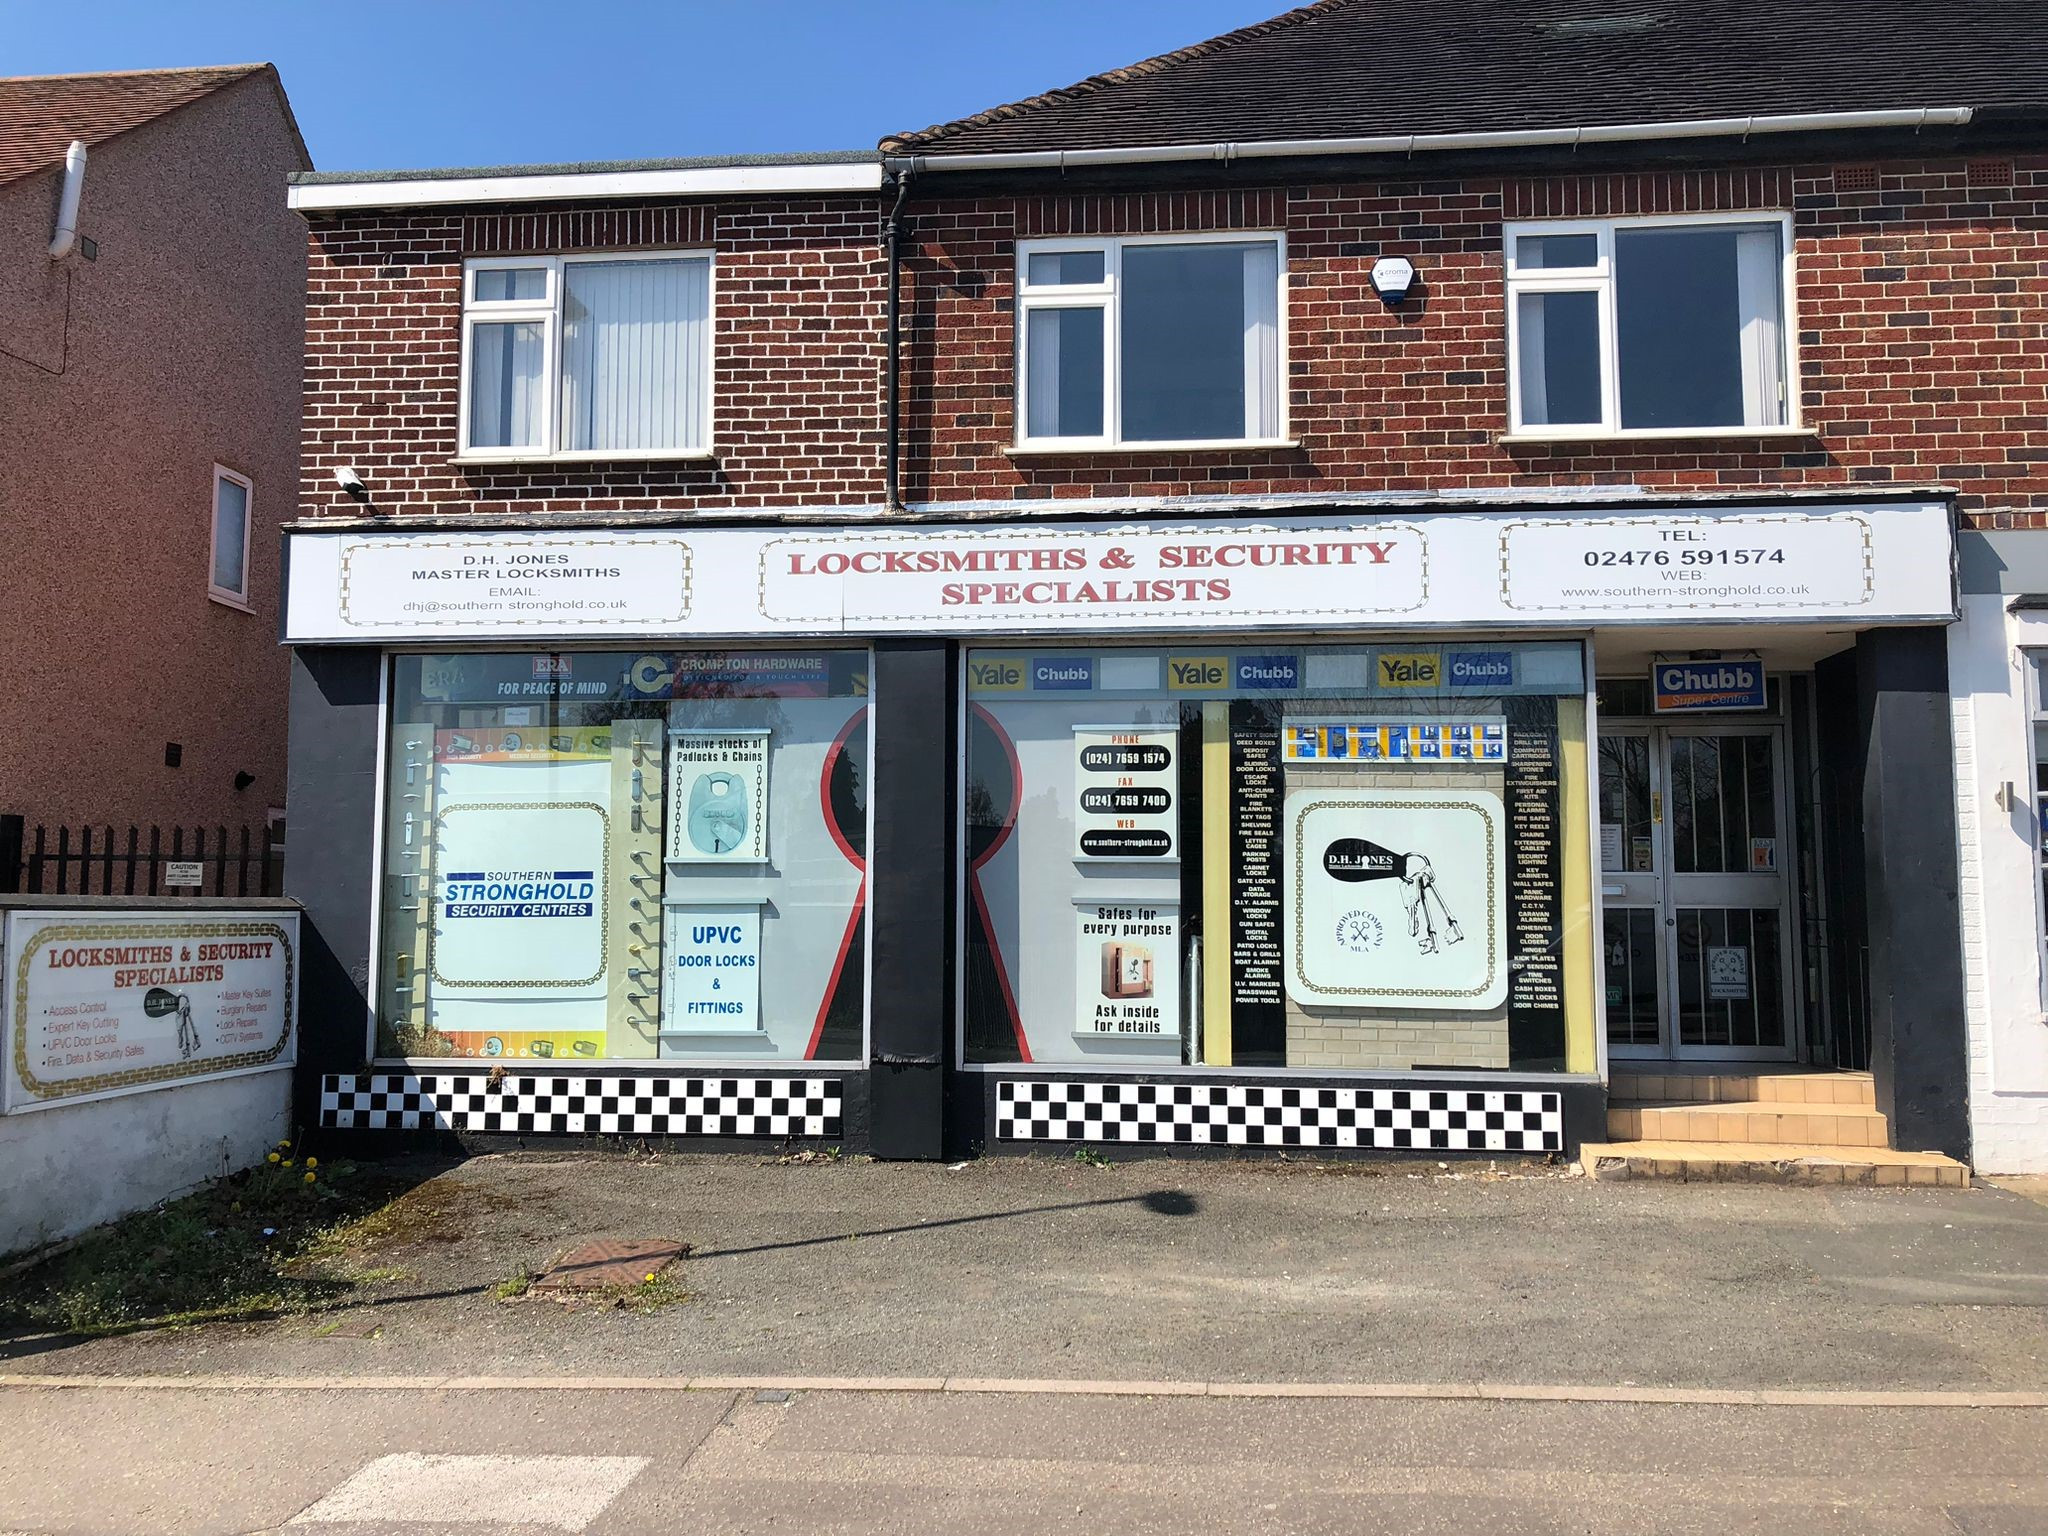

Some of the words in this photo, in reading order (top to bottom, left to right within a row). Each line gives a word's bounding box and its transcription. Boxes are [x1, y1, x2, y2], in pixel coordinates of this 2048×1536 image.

[1658, 530, 1707, 542] TEL:
[463, 555, 500, 566] D.H.
[505, 554, 569, 565] JONES
[786, 547, 1087, 576] LOCKSMITHS
[1098, 546, 1136, 571] &
[1158, 541, 1398, 569] SECURITY
[1584, 551, 1670, 567] 02476
[1681, 549, 1786, 565] 591574
[412, 570, 490, 580] MASTER
[496, 567, 621, 579] LOCKSMITHS
[1660, 570, 1707, 581] WEB:
[489, 587, 541, 597] EMAIL:
[941, 578, 1232, 606] SPECIALISTS
[1561, 584, 1810, 598] www.southern-stronghold.co.uk
[536, 659, 568, 672] ERA
[681, 659, 750, 670] CROMPTON
[754, 658, 822, 669] HARDWARE
[1453, 662, 1509, 676] Chubb
[971, 664, 1021, 685] Yale
[1036, 667, 1088, 681] Chubb
[1172, 663, 1224, 685] Yale
[1240, 665, 1294, 679] Chubb
[1381, 660, 1435, 682] Yale
[1663, 668, 1753, 691] Chubb
[498, 683, 519, 695] FOR
[523, 682, 556, 695] PEACE
[559, 682, 574, 694] OF
[577, 682, 607, 694] MIND
[1672, 694, 1707, 707] Super
[1710, 693, 1749, 705] Centre
[677, 739, 714, 749] Massive
[718, 739, 749, 749] stocks
[752, 738, 762, 749] of
[1111, 735, 1140, 744] PHONE
[677, 752, 718, 762] Padlocks
[722, 752, 728, 762] &
[732, 752, 762, 762] Chains
[1086, 752, 1112, 765] (024)
[1116, 753, 1140, 764] 7659
[1143, 753, 1165, 764] 1574
[1117, 777, 1133, 786] FAX
[1085, 795, 1111, 807] (024)
[1115, 795, 1139, 806] 7659
[1142, 795, 1167, 806] 7400
[1117, 820, 1135, 828] WEB
[1328, 854, 1353, 864] D.H.
[487, 871, 553, 881] SOUTHERN
[445, 883, 594, 901] STRONGHOLD
[451, 904, 520, 917] SECURITY
[522, 904, 587, 916] CENTRES
[1098, 907, 1132, 920] Safes
[1138, 908, 1157, 920] for
[692, 926, 742, 944] UPVC
[1083, 924, 1117, 936] every
[1123, 924, 1172, 937] purpose
[1336, 910, 1360, 946] APPROVED
[1362, 911, 1383, 949] COMPANY
[49, 945, 173, 969] LOCKSMITHS
[180, 946, 191, 961] &
[198, 943, 273, 961] SECURITY
[678, 955, 712, 967] DOOR
[715, 955, 755, 967] LOCKS
[114, 965, 224, 988] SPECIALISTS
[712, 977, 721, 990] &
[242, 990, 254, 1000] Key
[49, 1005, 78, 1016] Access
[80, 1001, 107, 1013] Control
[688, 1002, 743, 1014] FITTINGS
[1096, 1004, 1117, 1017] Ask
[1123, 1005, 1159, 1018] inside
[48, 1021, 74, 1034] Expert
[76, 1020, 90, 1031] Key
[92, 1017, 119, 1029] Cutting
[1095, 1019, 1113, 1032] for
[1118, 1020, 1160, 1033] details
[74, 1036, 92, 1048] Door
[94, 1034, 117, 1045] Locks
[66, 1053, 84, 1065] Data
[87, 1051, 92, 1062] &
[94, 1049, 123, 1061] Security
